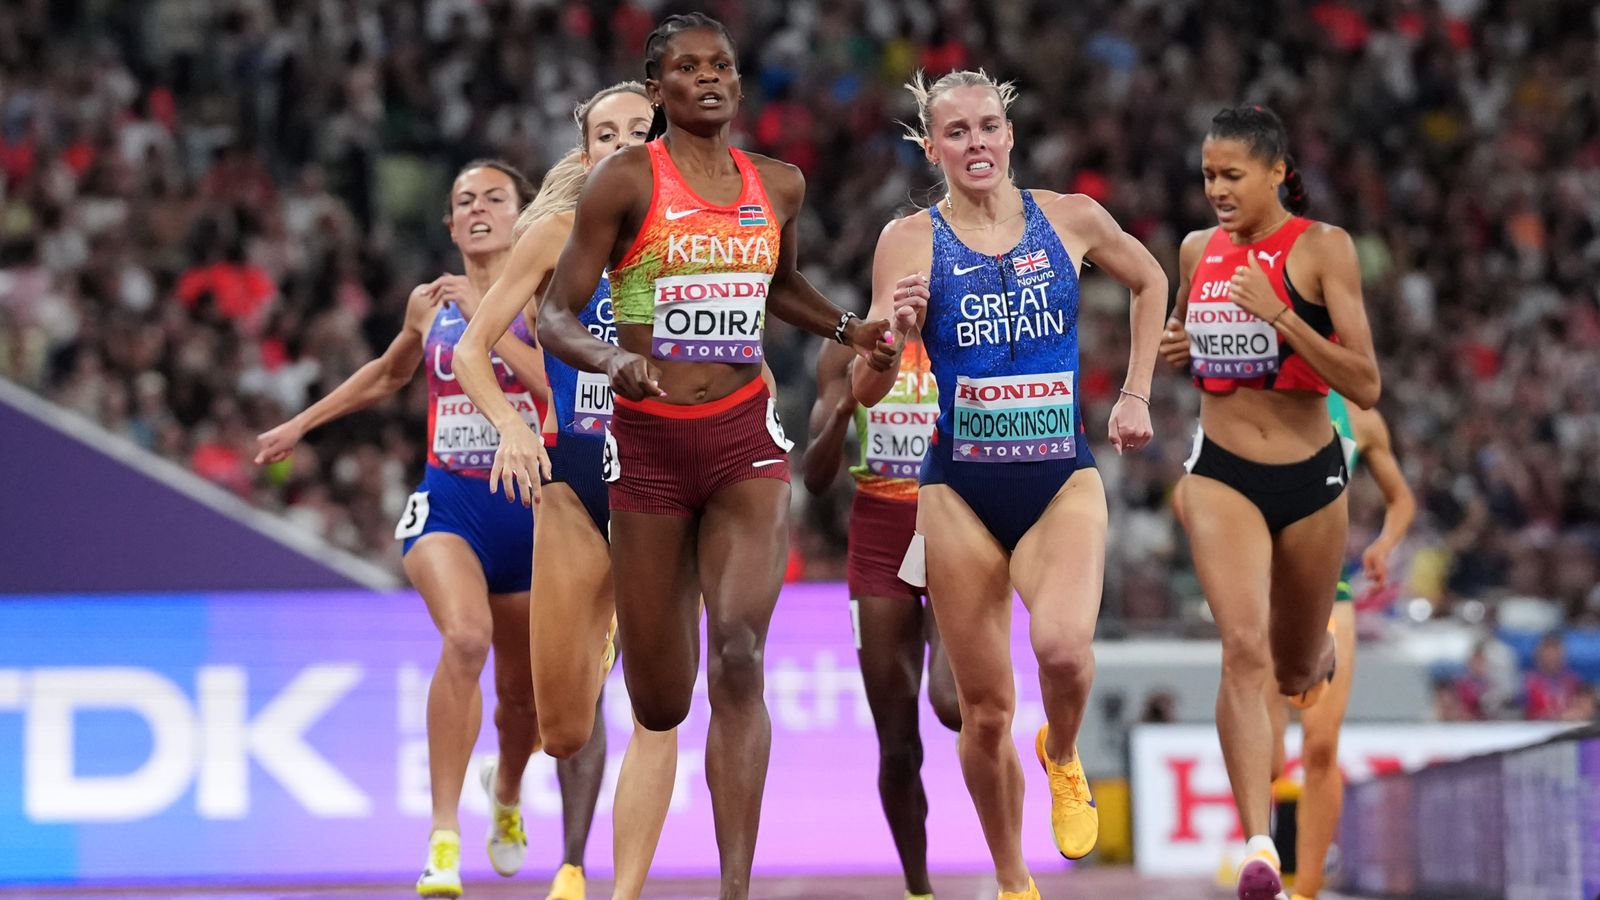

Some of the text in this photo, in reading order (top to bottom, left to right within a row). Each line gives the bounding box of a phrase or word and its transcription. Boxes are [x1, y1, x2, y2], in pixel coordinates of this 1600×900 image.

[667, 233, 772, 266] KENYA
[1017, 270, 1055, 287] Novuna
[658, 282, 767, 302] HONDA
[960, 282, 1050, 320] GREAT
[957, 309, 1063, 347] BRITAIN
[958, 381, 1071, 402] HONDA
[442, 401, 533, 416] HOA
[870, 411, 938, 425] HON
[959, 408, 1070, 437] HODGKINSON
[873, 434, 887, 455] S.
[0, 663, 373, 824] DK
